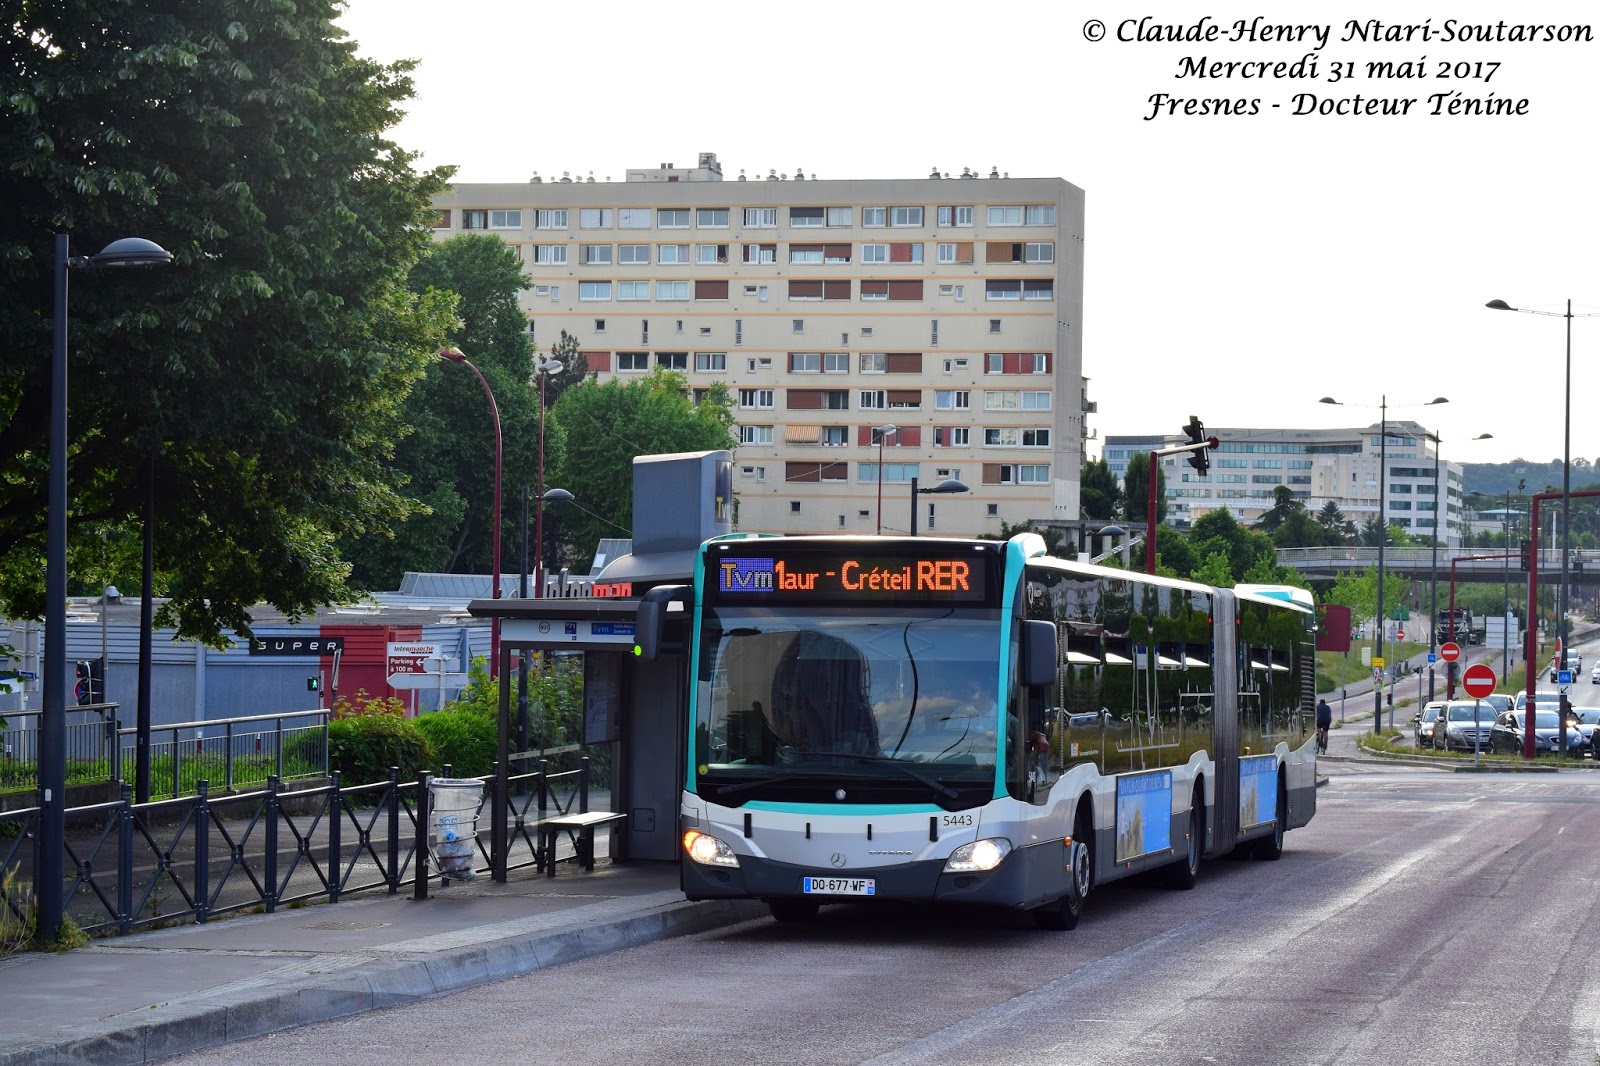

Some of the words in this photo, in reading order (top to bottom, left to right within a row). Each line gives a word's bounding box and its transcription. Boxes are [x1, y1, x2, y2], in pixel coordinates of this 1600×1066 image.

[841, 560, 911, 590] Créteil
[917, 561, 970, 590] RER
[390, 657, 414, 666] Parking
[943, 814, 973, 827] 5443
